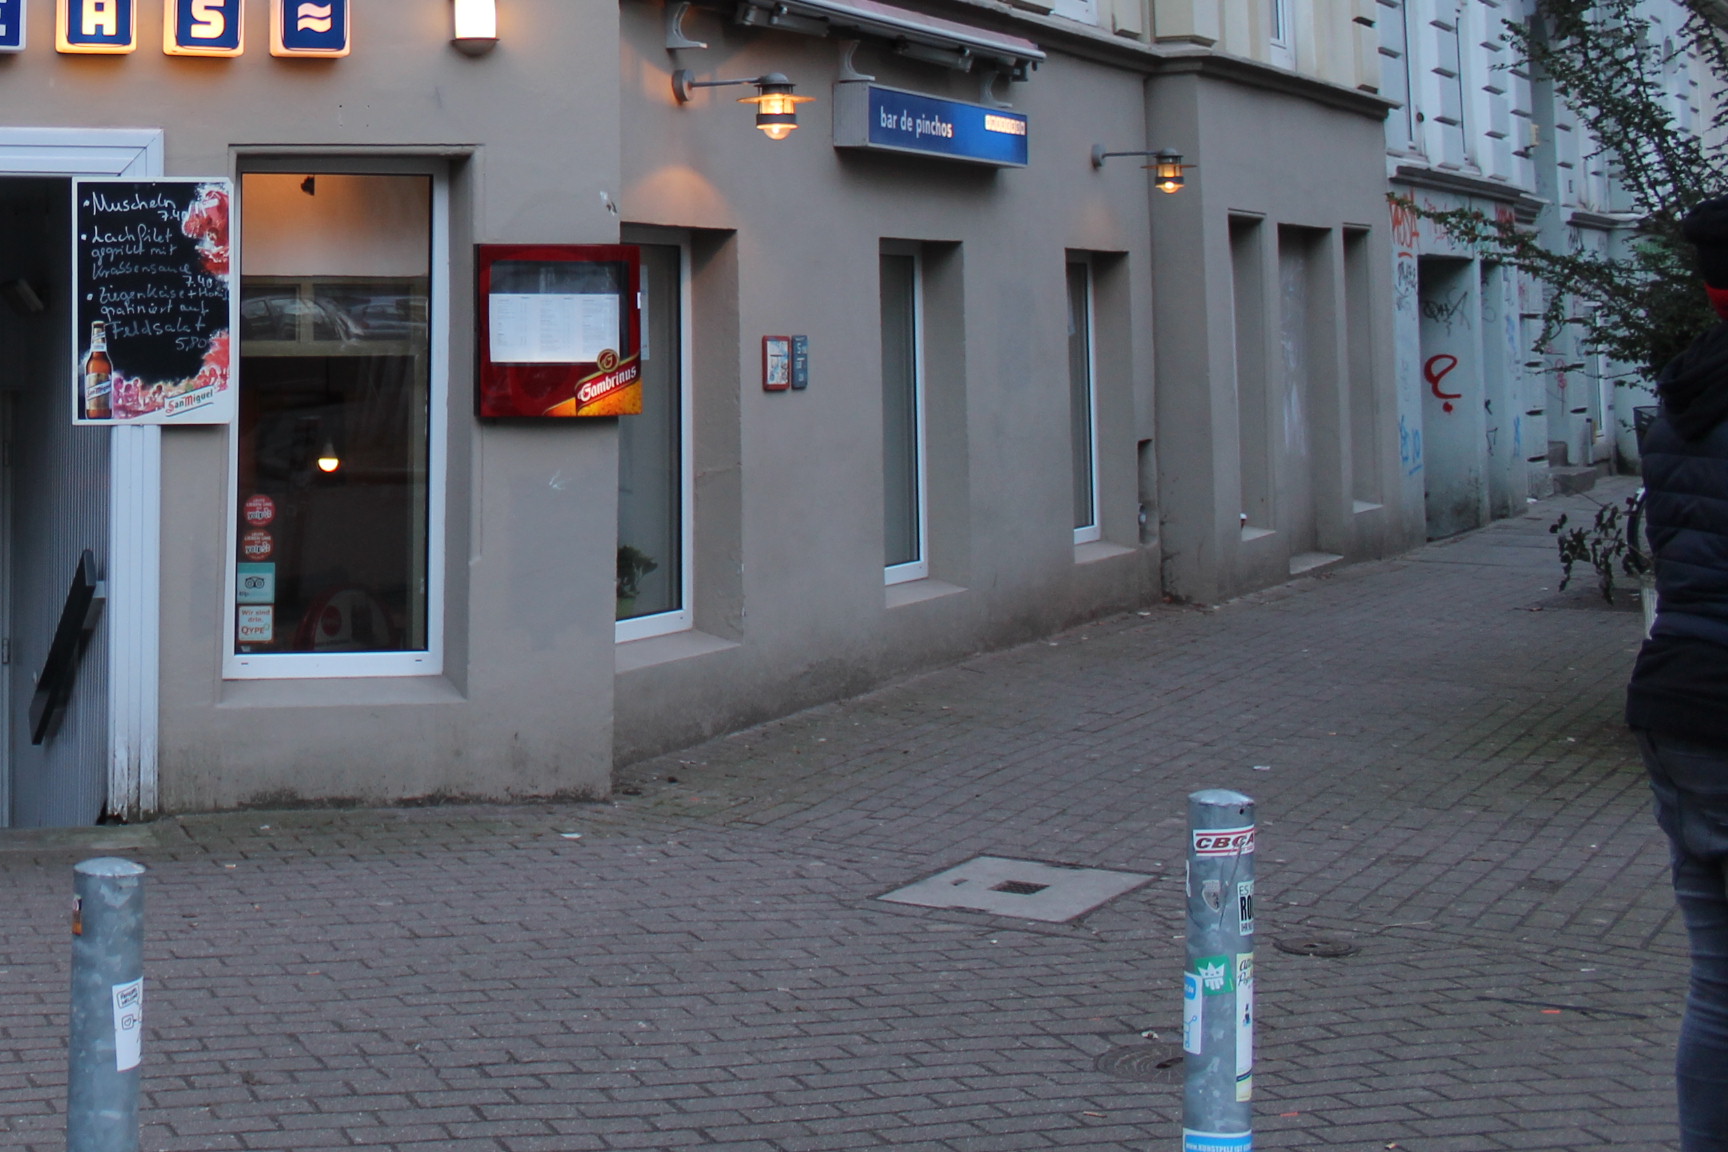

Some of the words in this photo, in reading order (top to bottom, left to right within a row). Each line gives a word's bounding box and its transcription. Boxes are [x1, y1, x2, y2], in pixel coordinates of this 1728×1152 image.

[880, 105, 898, 129] bar
[900, 109, 913, 132] de
[915, 114, 953, 139] pinchos
[92, 191, 176, 215] Muscheln
[150, 245, 177, 255] mit
[104, 316, 206, 339] Feldsalat
[578, 366, 637, 402] Gambrinus
